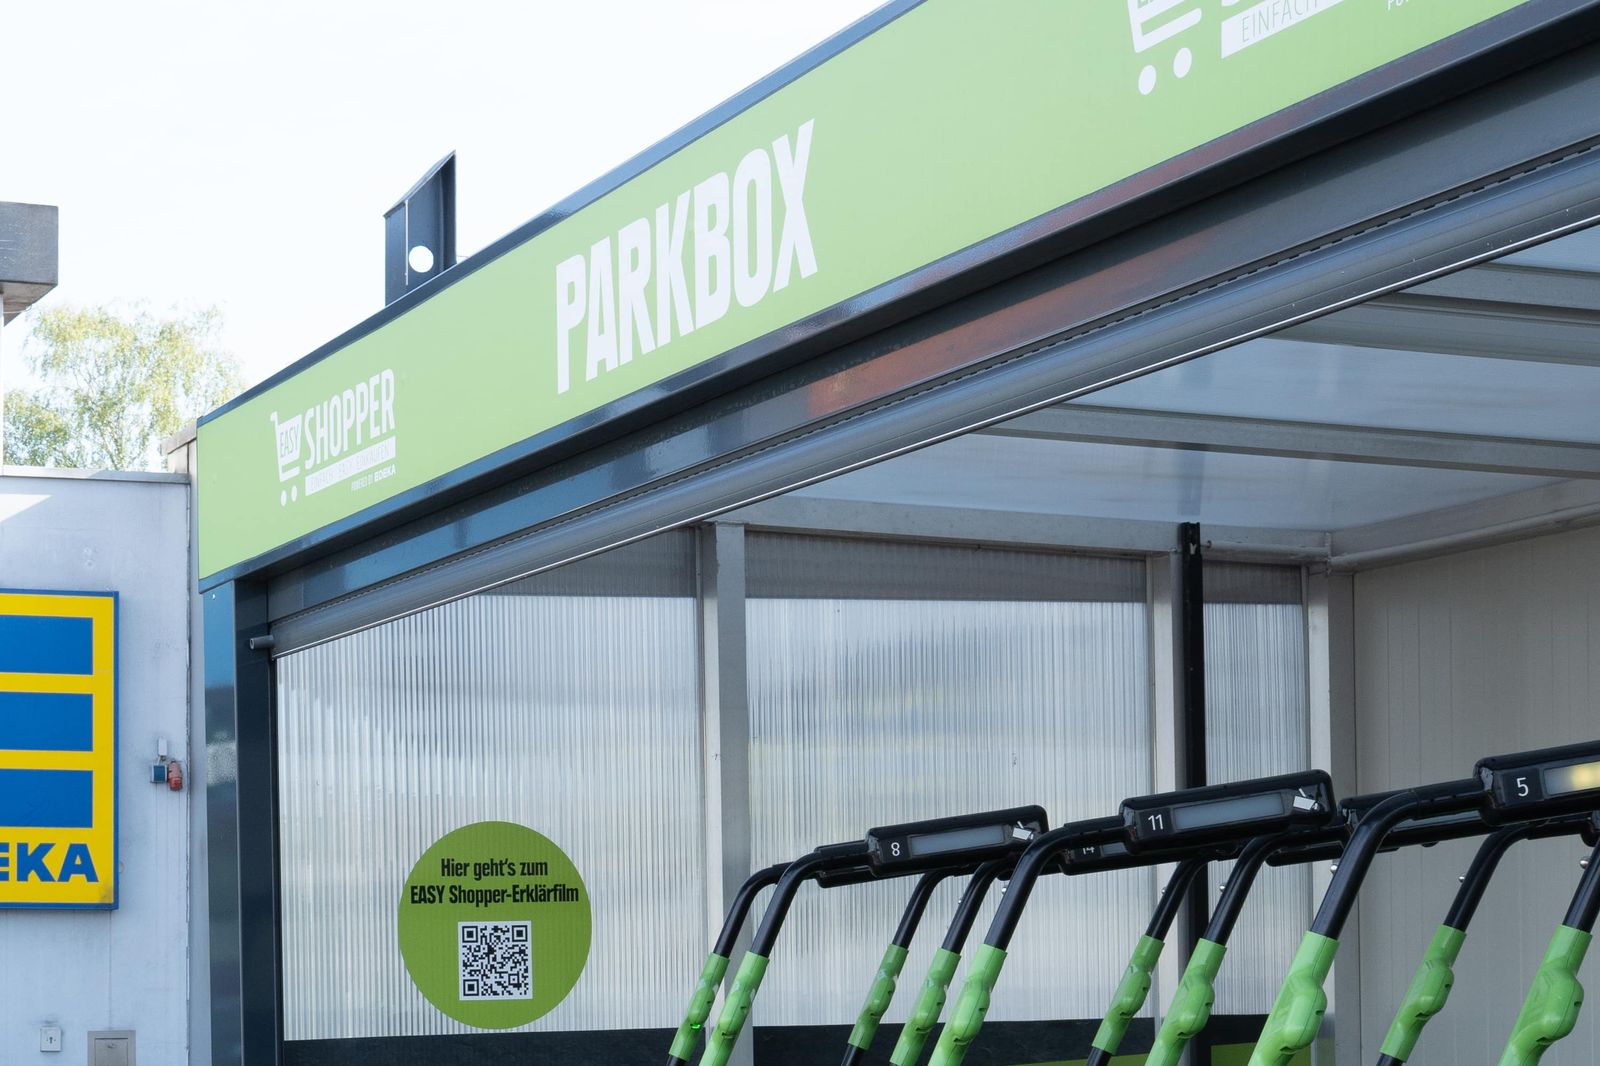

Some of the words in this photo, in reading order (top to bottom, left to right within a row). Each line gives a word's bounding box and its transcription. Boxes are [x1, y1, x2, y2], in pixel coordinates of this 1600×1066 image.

[556, 118, 818, 395] PARKBOX
[304, 368, 396, 470] SHOPPER
[280, 422, 300, 459] EASY
[1516, 777, 1530, 797] 5
[1148, 814, 1164, 832] 11
[891, 842, 900, 857] 8
[441, 858, 469, 877] Hier
[520, 861, 548, 876] zum
[410, 885, 445, 904] EASY
[449, 884, 579, 907] Shopper-Erklärfilm
